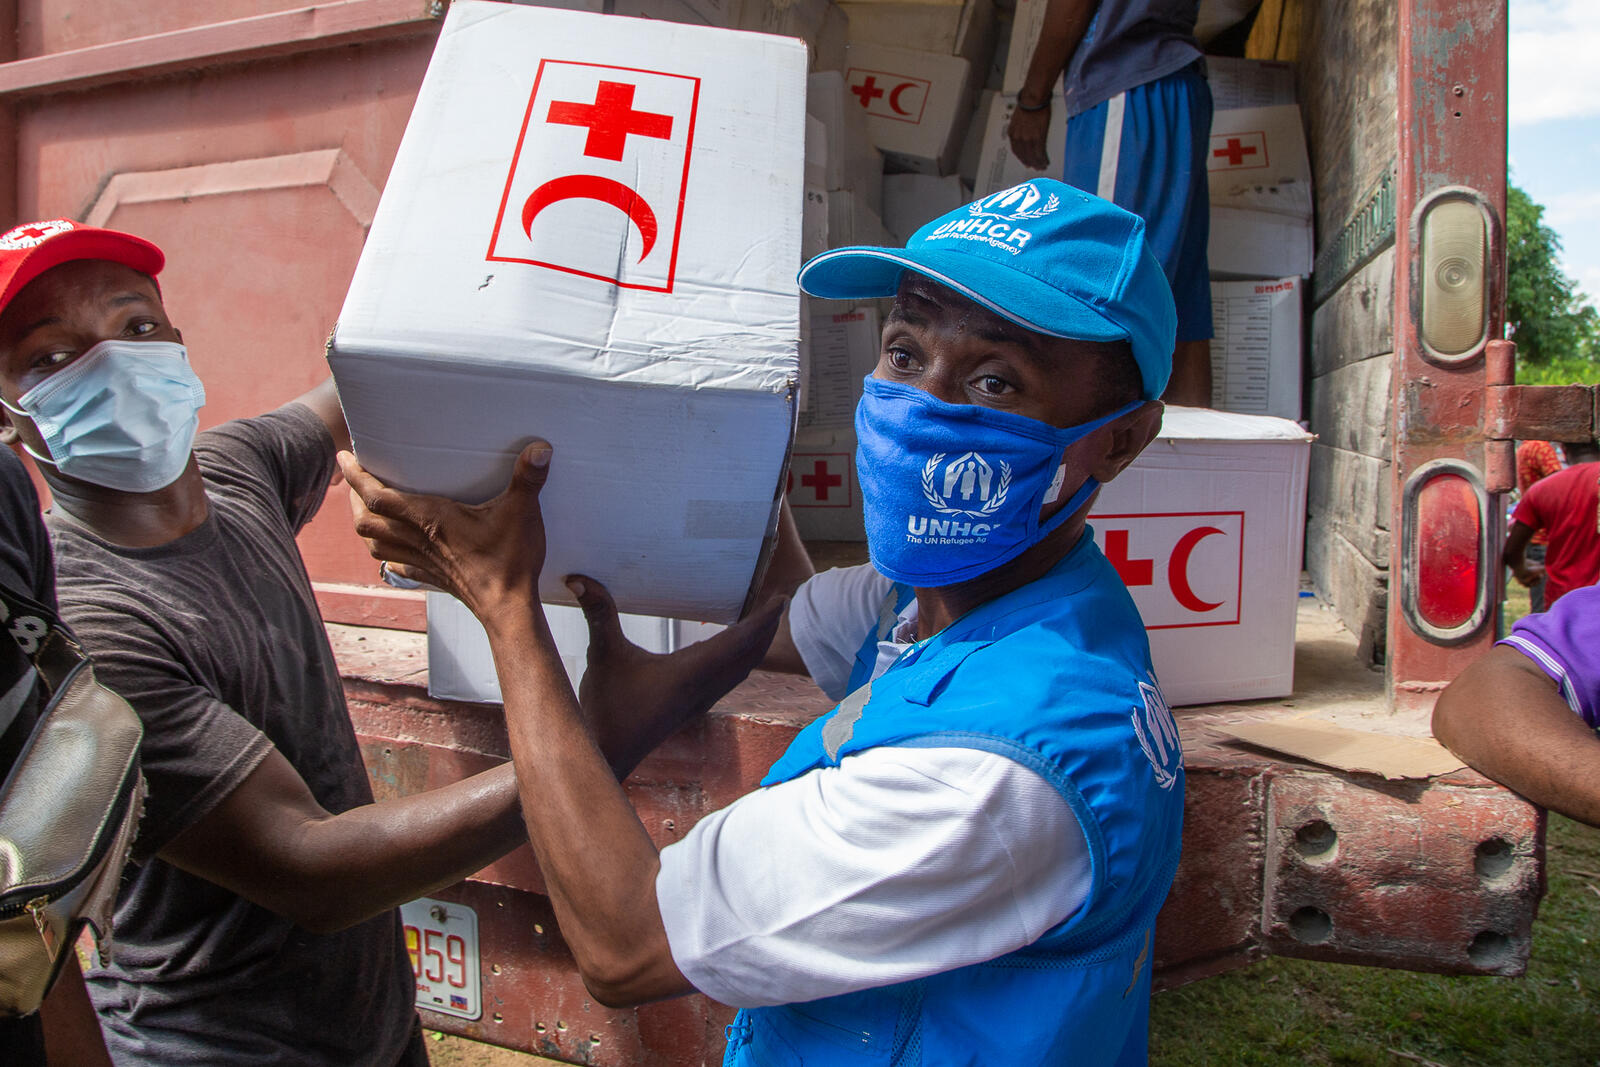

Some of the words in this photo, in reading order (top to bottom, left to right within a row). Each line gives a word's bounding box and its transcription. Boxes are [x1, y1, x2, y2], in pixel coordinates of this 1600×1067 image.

[933, 219, 1032, 247] UNHCR
[985, 237, 1021, 255] Agency
[908, 515, 1000, 536] UNHC
[906, 534, 922, 543] The
[940, 537, 974, 545] Refugee
